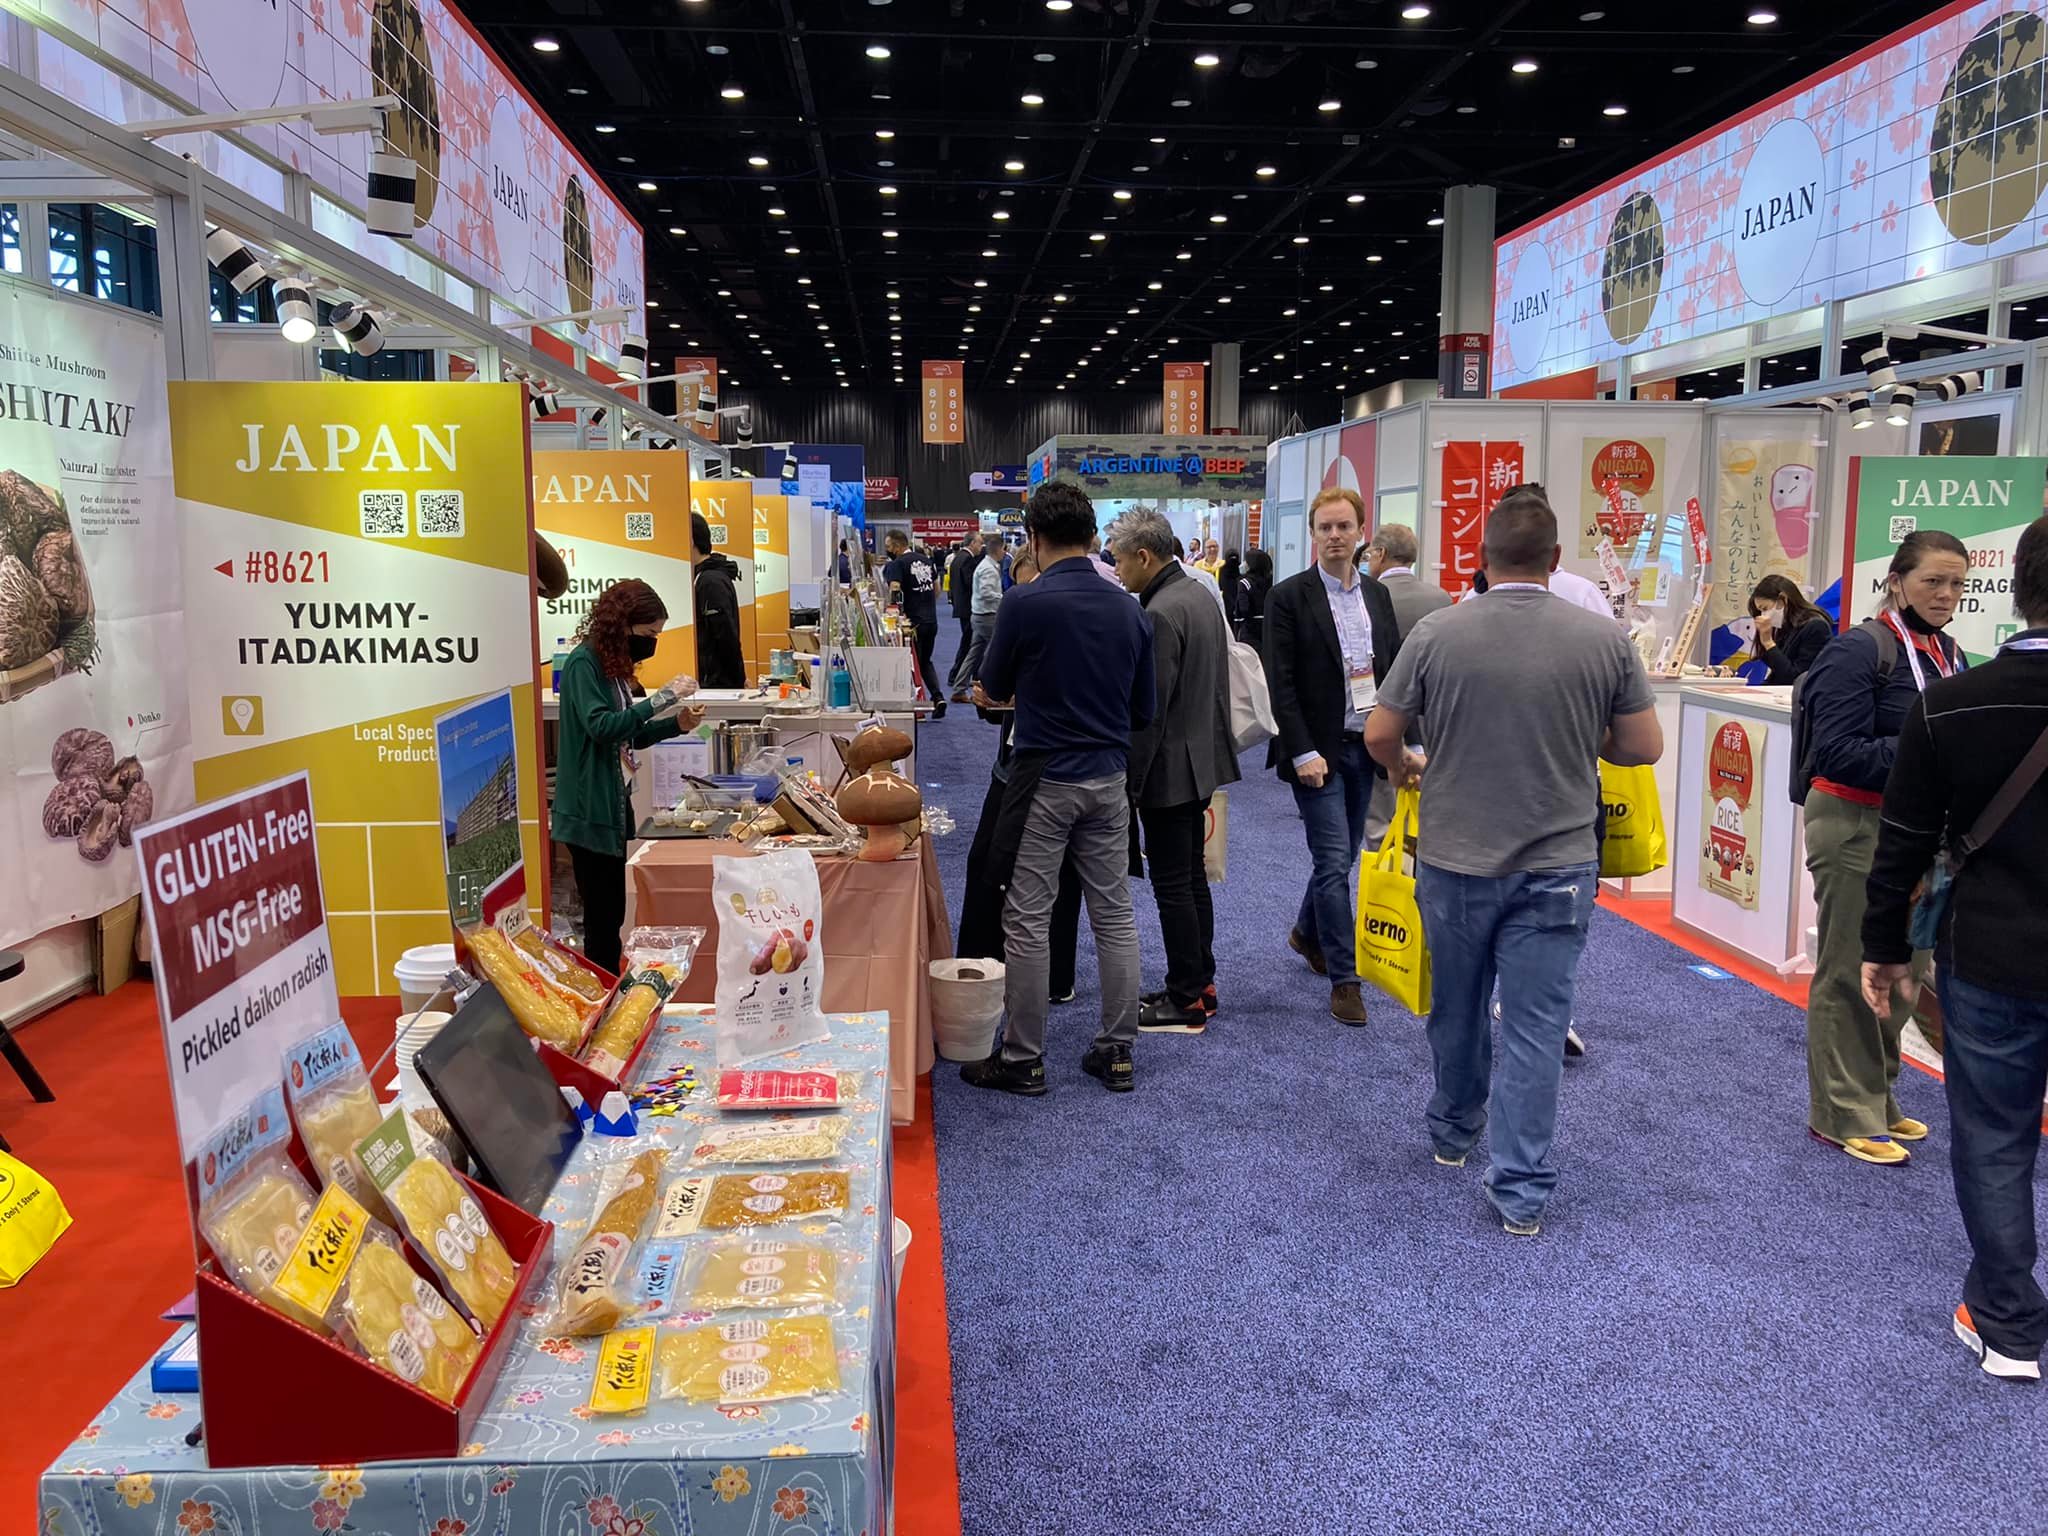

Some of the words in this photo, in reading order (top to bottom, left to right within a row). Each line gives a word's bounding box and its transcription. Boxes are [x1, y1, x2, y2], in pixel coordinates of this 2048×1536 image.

[494, 165, 528, 224] JAPAN
[1741, 183, 1817, 241] JAPAN
[1511, 289, 1550, 325] JAPAN
[46, 354, 106, 380] Mushroom
[236, 424, 460, 472] JAPAN
[60, 458, 97, 474] Natural
[1079, 458, 1184, 475] ARGENTINE
[1205, 458, 1246, 474] BEEF
[1598, 459, 1648, 473] NIIGATA
[864, 479, 890, 488] AVITA
[1891, 480, 2014, 506] JAPAN
[928, 520, 969, 528] BELLAVITA
[1450, 477, 1481, 604] コシヒカ
[245, 551, 330, 584] #8621
[1970, 550, 2003, 567] 8821
[1963, 579, 2015, 593] ERAG
[285, 603, 429, 629] YUMMY-
[546, 599, 597, 615] SHII
[1959, 598, 1985, 613] TD.
[238, 637, 479, 664] ITADAKIMASU
[354, 723, 394, 741] Local
[398, 723, 432, 744] Spec
[1714, 748, 1748, 776] NIIGATA
[1717, 806, 1740, 832] RICE
[155, 808, 310, 906] GLUTEN-Free
[191, 883, 302, 973] MSG-Free
[1364, 912, 1406, 944] terno
[182, 1006, 241, 1074] Pickled
[245, 980, 290, 1028] daikon
[292, 947, 329, 995] radish
[1031, 1067, 1045, 1077] PU
[1111, 1062, 1133, 1072] PUMA
